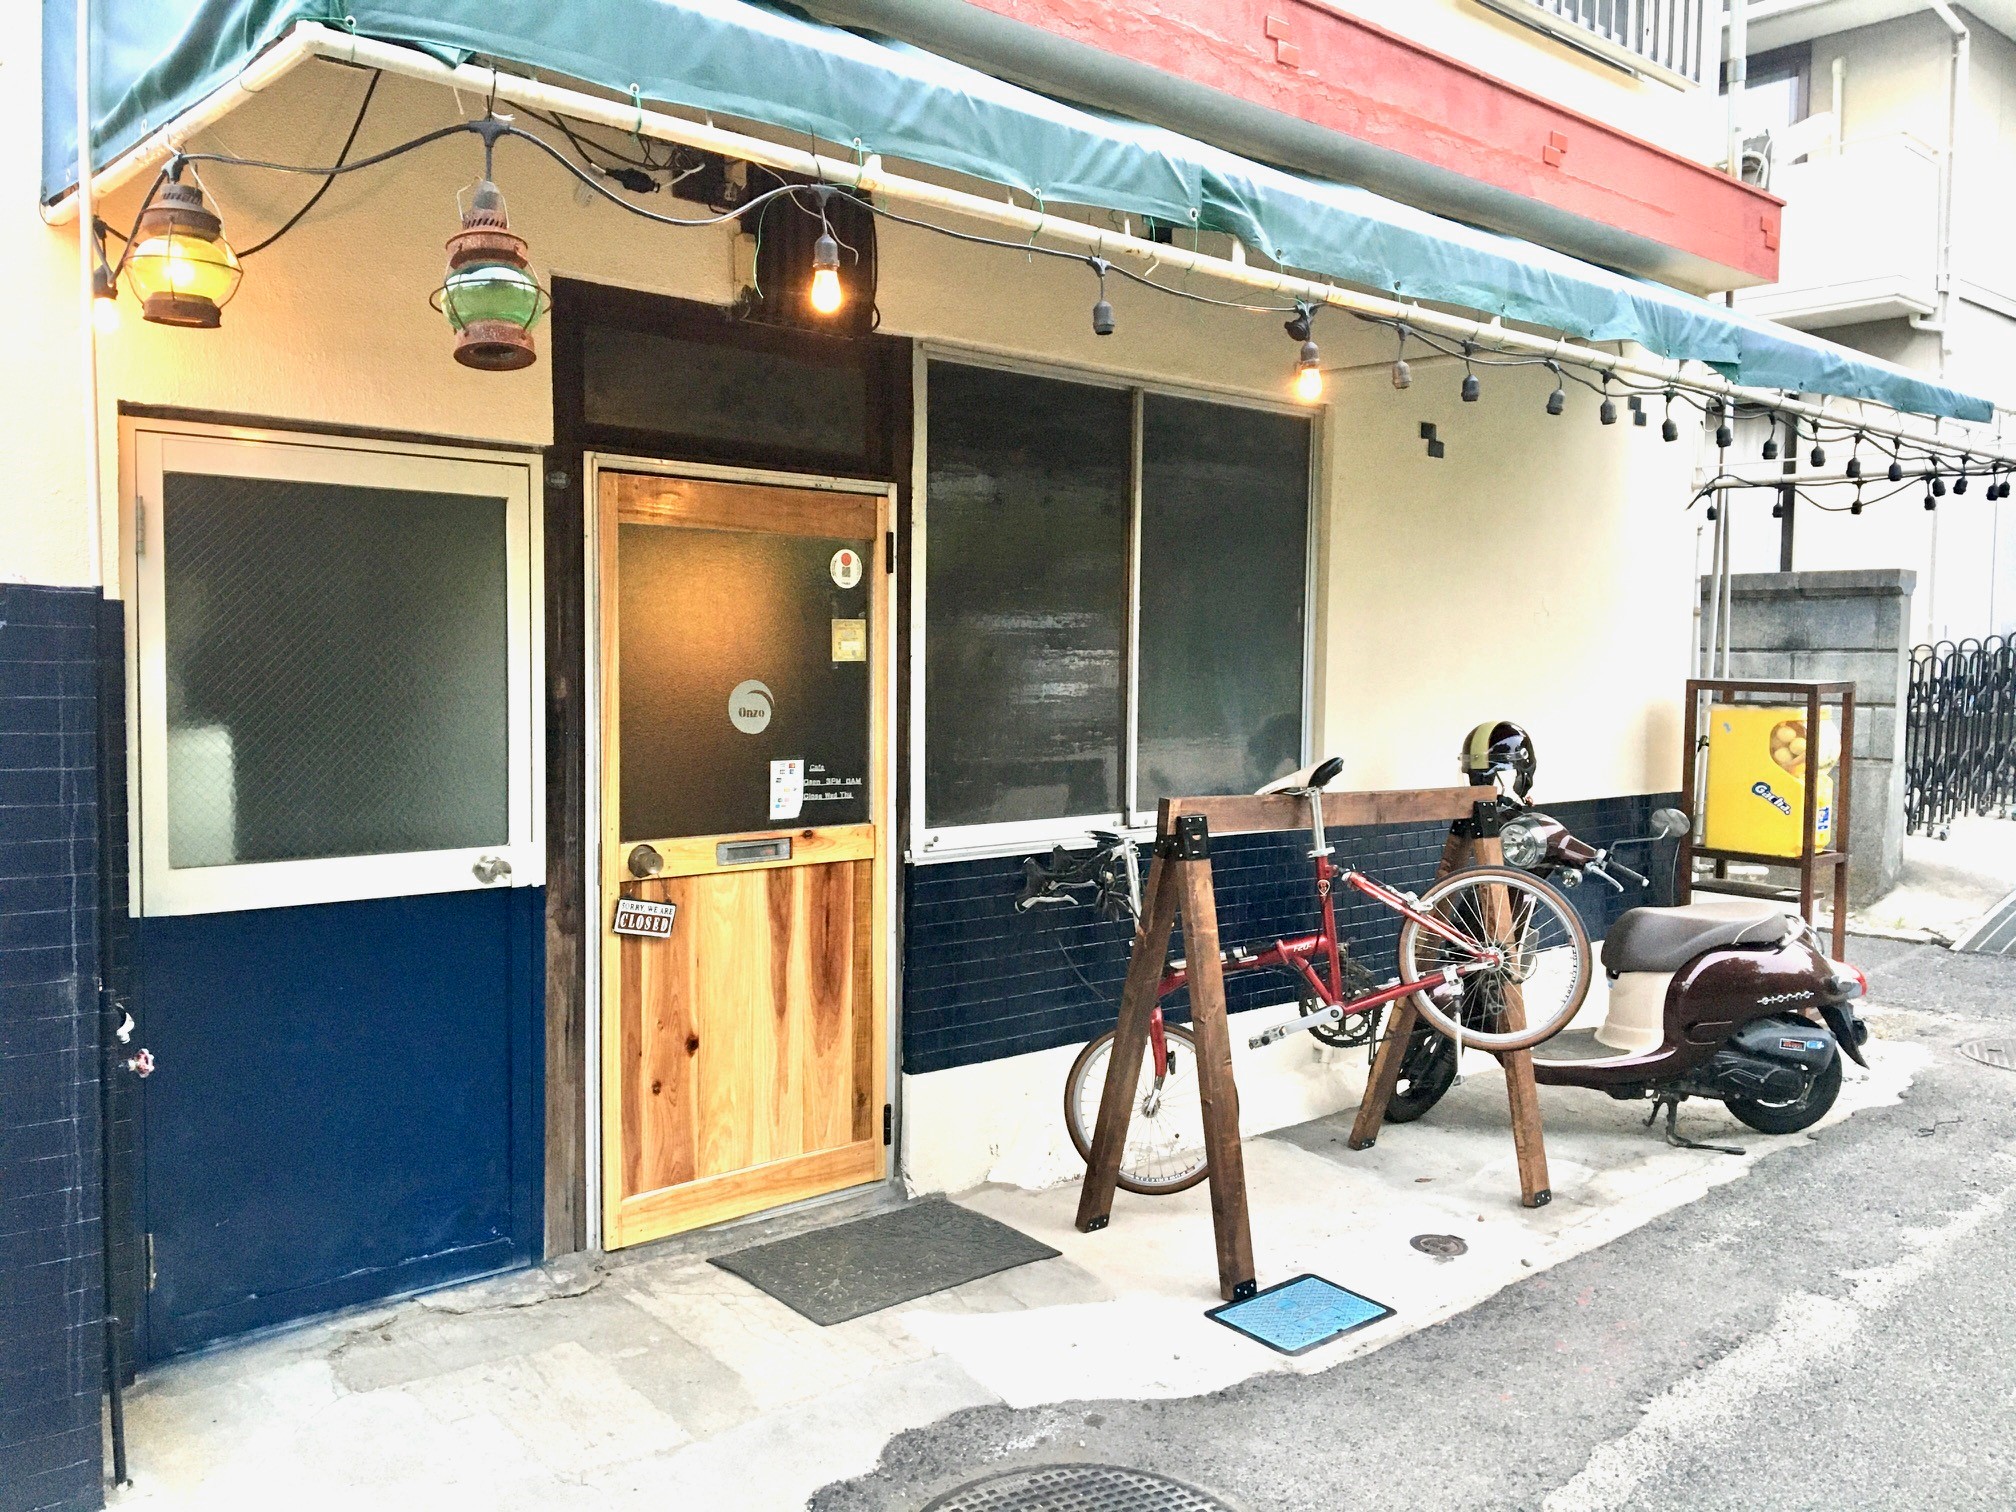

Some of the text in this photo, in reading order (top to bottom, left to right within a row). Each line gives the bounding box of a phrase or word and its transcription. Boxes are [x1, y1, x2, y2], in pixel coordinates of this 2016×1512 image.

[738, 707, 765, 717] Onzo
[648, 905, 658, 913] WE
[660, 907, 673, 915] ARE
[620, 913, 669, 932] CLOSED
